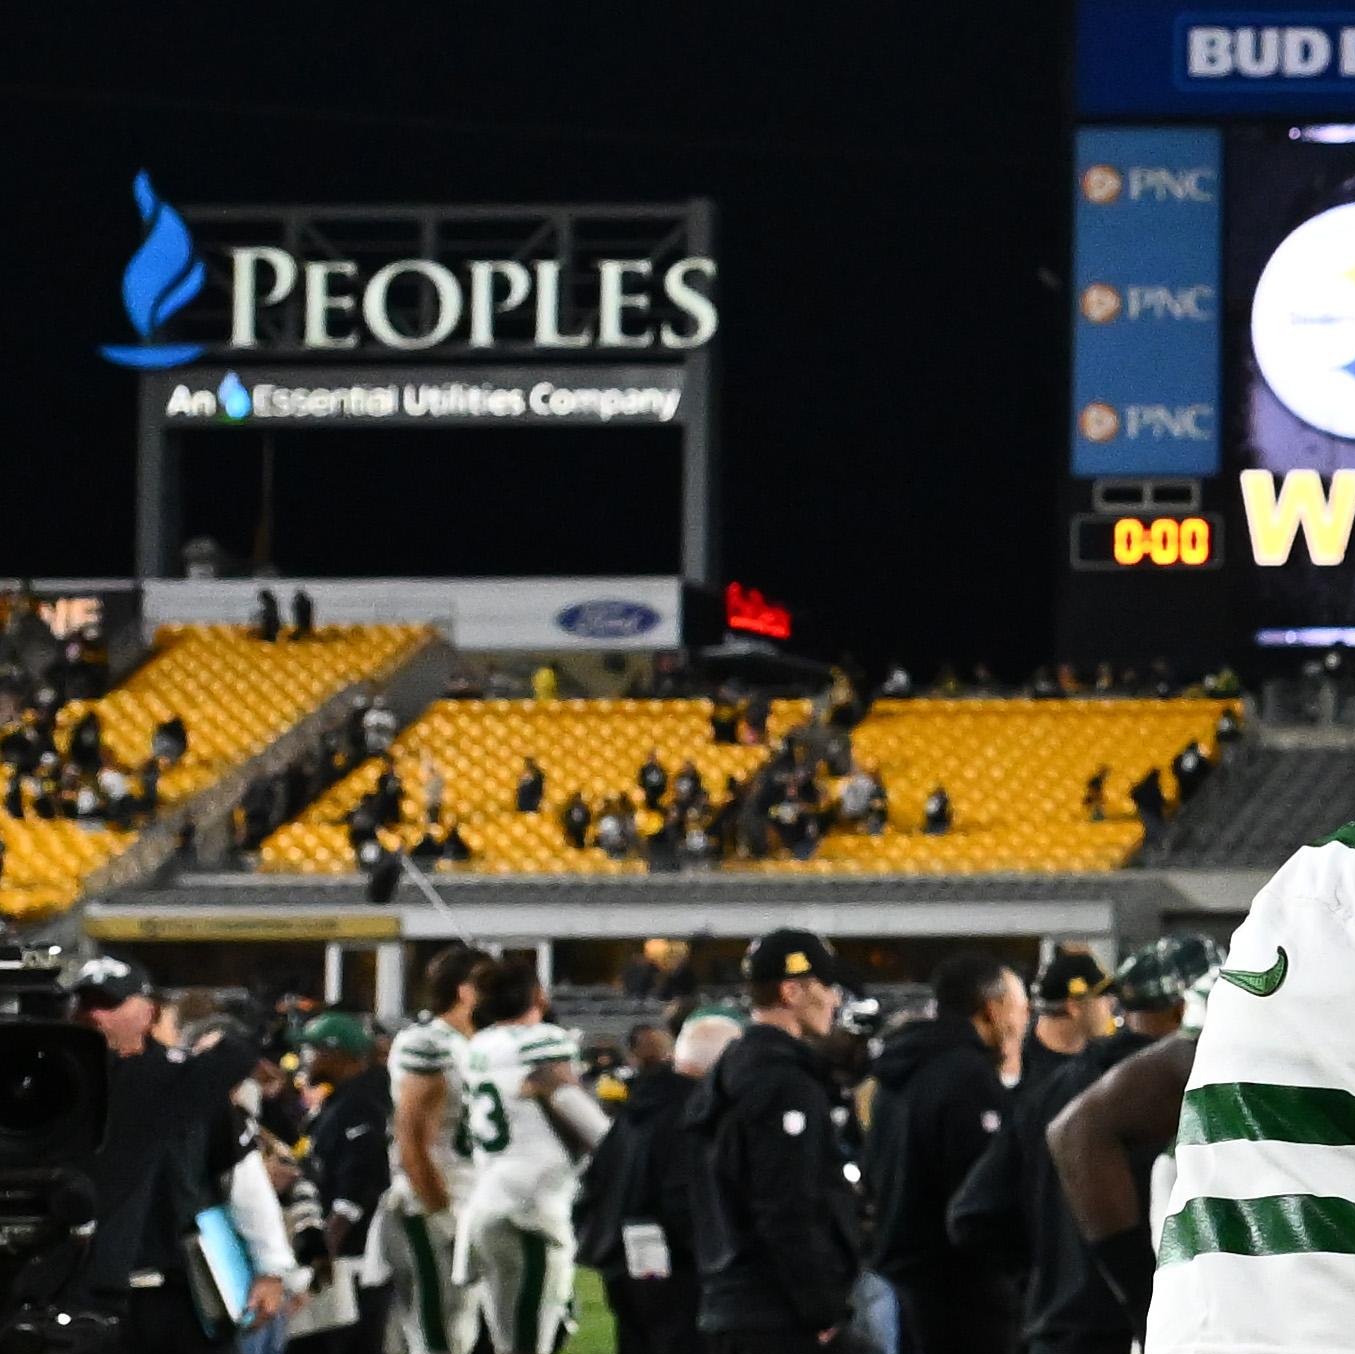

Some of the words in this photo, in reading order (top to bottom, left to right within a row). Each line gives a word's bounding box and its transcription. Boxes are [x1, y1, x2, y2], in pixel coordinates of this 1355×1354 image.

[1187, 26, 1331, 77] BUD
[1127, 168, 1213, 202] PNC
[230, 246, 718, 349] PEOPLES
[1127, 286, 1214, 321] PNC
[166, 384, 218, 417] An
[253, 383, 398, 417] Essential
[402, 382, 525, 417] Utilities
[529, 381, 682, 422] Company
[1126, 404, 1212, 440] PNC
[1113, 517, 1210, 566] 0:00
